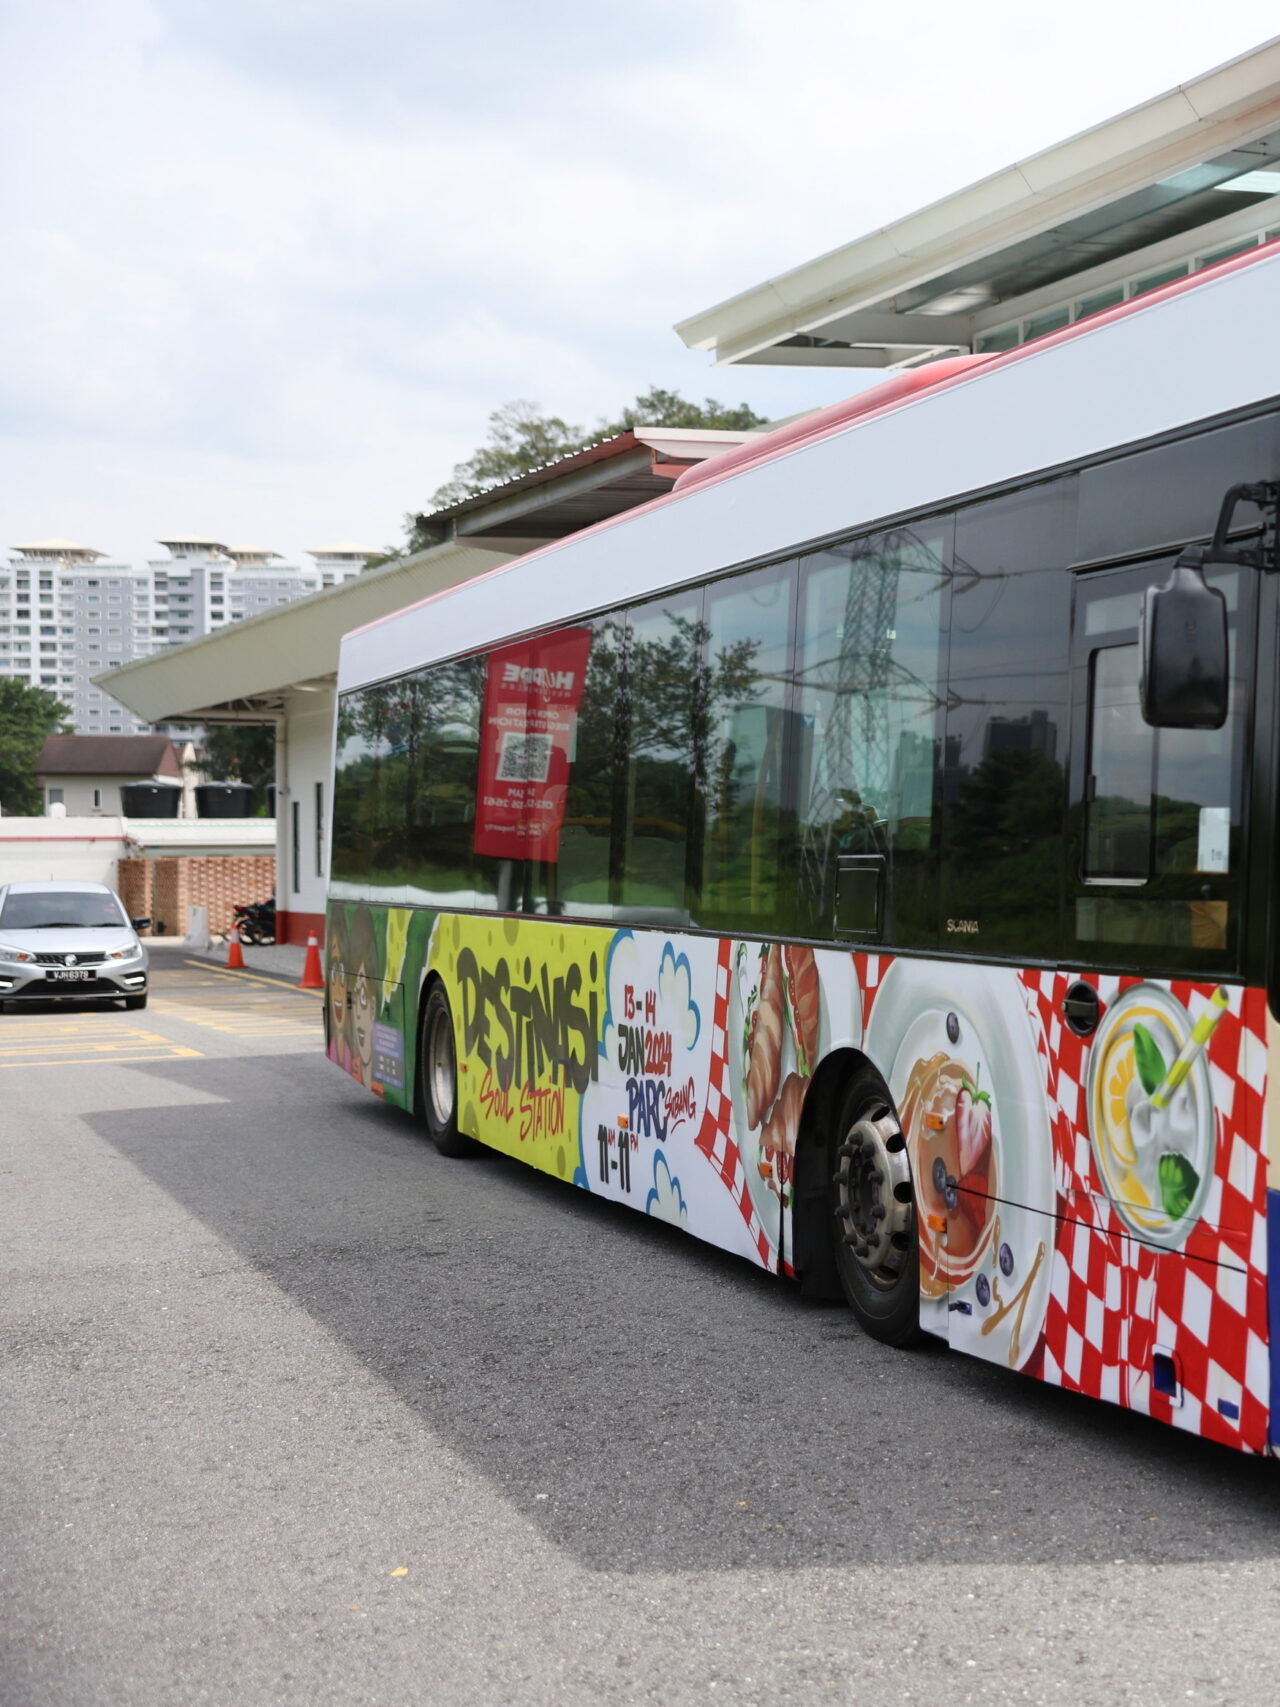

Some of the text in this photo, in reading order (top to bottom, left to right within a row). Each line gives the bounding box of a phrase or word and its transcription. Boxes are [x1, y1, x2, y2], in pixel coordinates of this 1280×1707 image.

[618, 1023, 672, 1077] JAN 2024
[480, 1068, 514, 1124] SOUL
[625, 1077, 667, 1142] PARC
